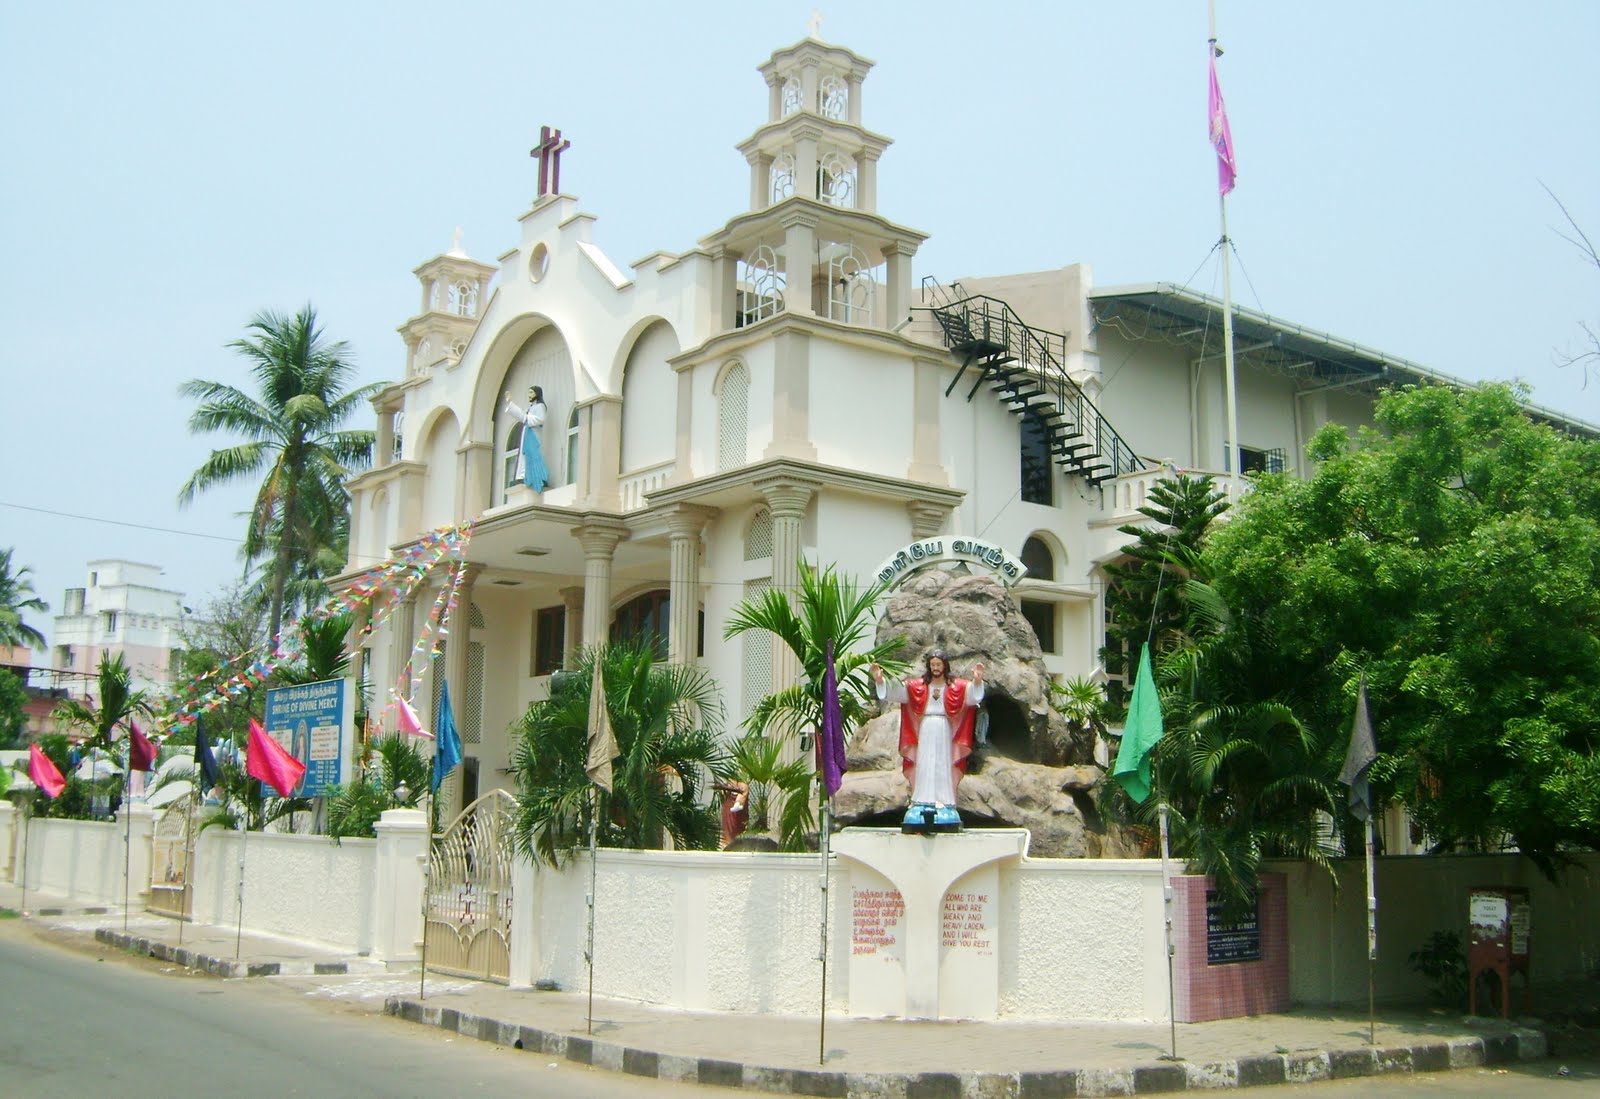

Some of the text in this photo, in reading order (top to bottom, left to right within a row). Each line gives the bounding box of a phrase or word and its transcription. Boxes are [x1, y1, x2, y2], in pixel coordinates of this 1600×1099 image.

[952, 540, 1019, 578] வாழ்க
[272, 703, 290, 715] SHRINE
[290, 701, 298, 712] OF
[299, 700, 317, 712] DIVINE
[318, 697, 338, 710] MERCY
[945, 893, 989, 902] COME TO ME
[944, 903, 956, 911] ALL
[970, 904, 983, 912] ARE
[943, 912, 982, 921] WEARY AND
[942, 930, 956, 939] AND
[961, 931, 979, 940] WILL
[942, 939, 957, 947] GIVE
[973, 940, 991, 948] REST
